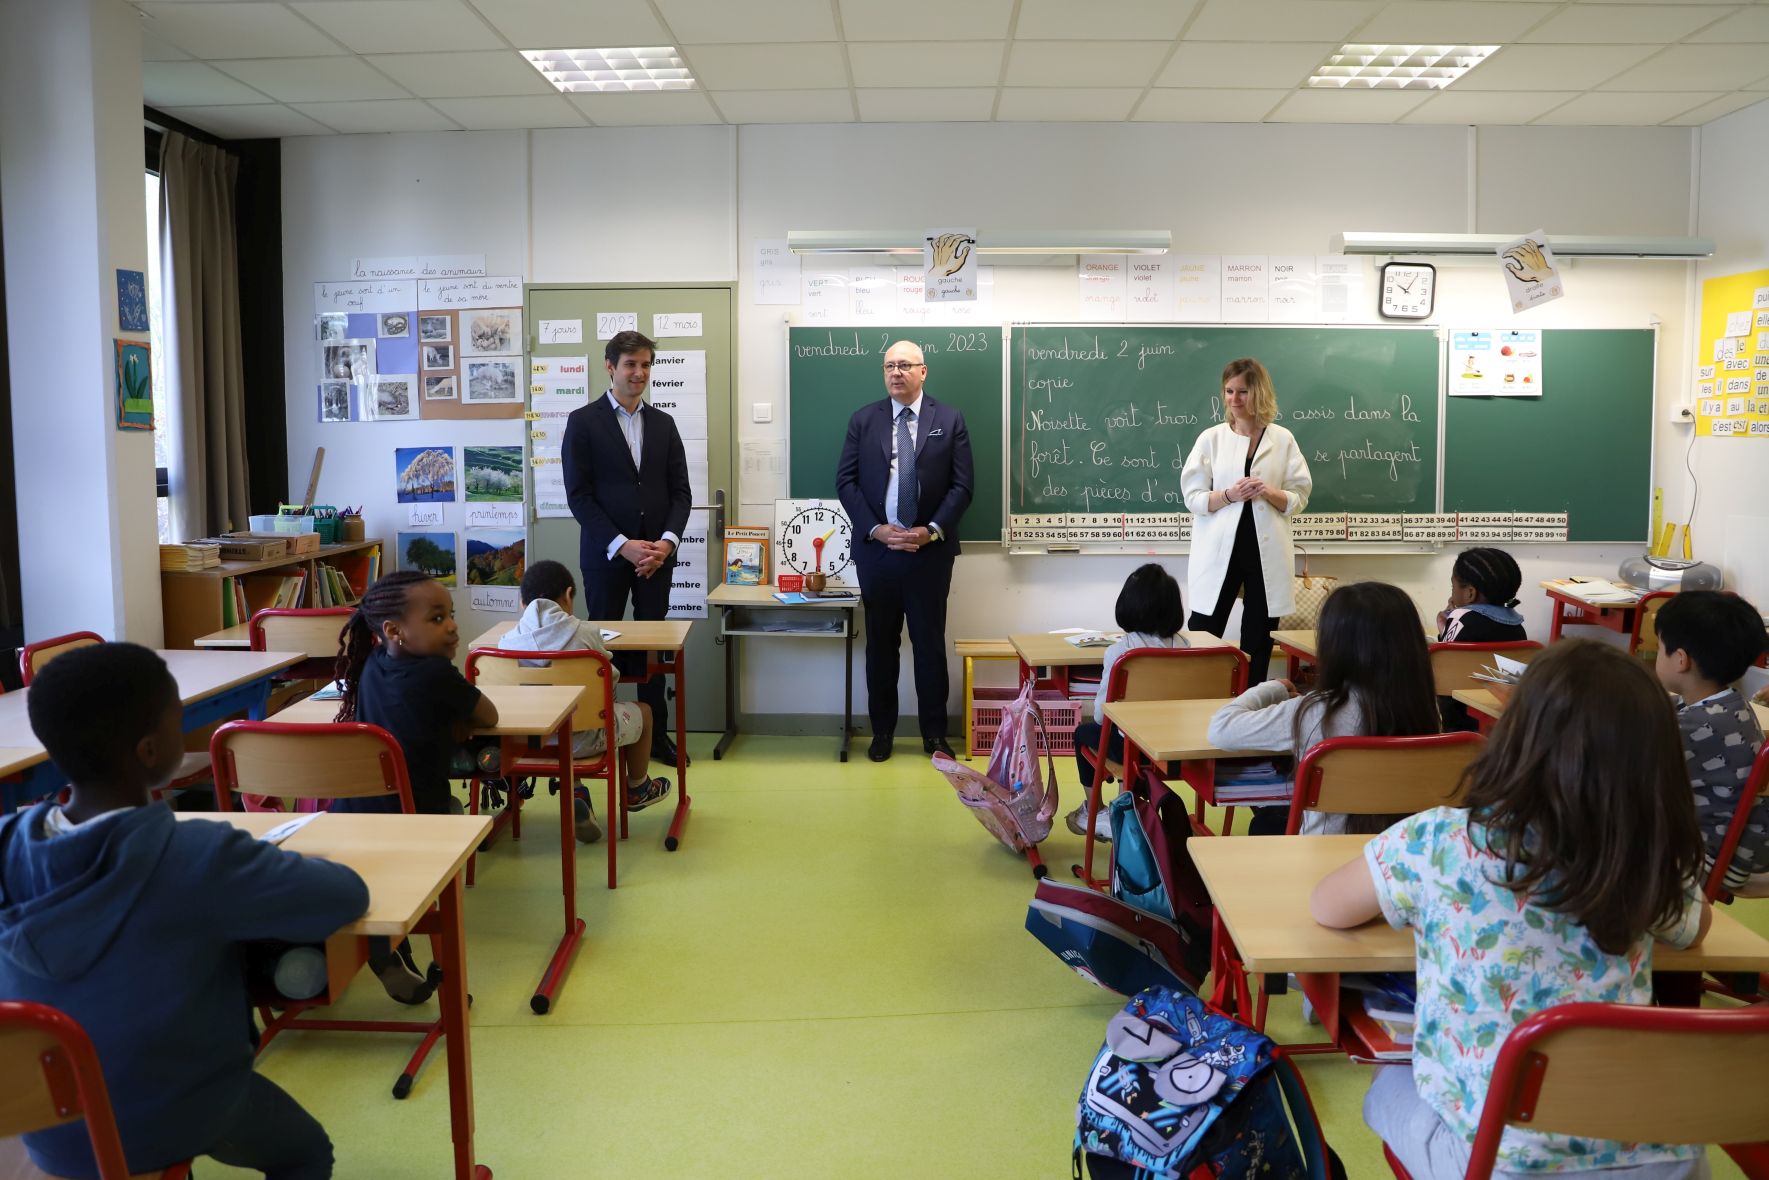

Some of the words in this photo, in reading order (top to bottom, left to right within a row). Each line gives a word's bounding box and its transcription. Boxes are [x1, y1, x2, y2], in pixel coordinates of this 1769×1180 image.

[370, 267, 415, 276] naissance
[422, 263, 436, 275] des
[441, 267, 484, 276] animaux
[938, 276, 962, 284] gauche
[438, 283, 458, 300] jeune
[482, 280, 493, 290] du
[904, 286, 922, 294] rouge
[599, 316, 635, 334] 2023
[657, 316, 669, 330] 12
[672, 320, 698, 329] mois
[543, 323, 550, 332] 7
[551, 324, 576, 342] jours
[795, 331, 869, 357] vendredi
[946, 332, 987, 352] 2023
[1736, 339, 1744, 351] le
[1029, 336, 1108, 360] vendredi
[1117, 340, 1128, 357] 2
[1138, 344, 1175, 370] juin
[652, 357, 685, 366] janvier
[1726, 360, 1747, 369] avec
[560, 365, 584, 373] lundi
[1700, 367, 1714, 376] sur
[1756, 369, 1766, 380] de
[652, 379, 684, 388] février
[1029, 376, 1074, 402] copie
[1702, 383, 1712, 394] les
[1728, 379, 1749, 391] dans
[1758, 385, 1768, 395] un
[556, 386, 584, 395] mardi
[1027, 409, 1091, 431] Noisette
[1105, 402, 1142, 427] voit
[1155, 400, 1198, 425] trois
[1293, 406, 1335, 420] assis
[1344, 395, 1391, 420] dans
[1402, 395, 1421, 422] la
[1731, 402, 1740, 411] au
[1747, 400, 1755, 412] la
[1758, 403, 1767, 414] et
[1713, 421, 1731, 432] c'est
[1121, 445, 1160, 468] sont
[1314, 449, 1330, 462] se
[1338, 439, 1421, 481] partagent
[1043, 475, 1067, 497] des
[1081, 478, 1130, 512] pièces
[469, 504, 518, 524] printemps
[803, 515, 810, 524] 11
[815, 512, 824, 521] 12
[831, 515, 835, 524] 1
[792, 525, 801, 534] 10
[840, 525, 846, 534] 2
[787, 539, 793, 548] 9
[845, 539, 850, 548] 3
[791, 552, 797, 562] 8
[839, 552, 845, 562] 4
[802, 561, 808, 570] 7
[830, 562, 835, 571] 5
[472, 592, 514, 607] automne
